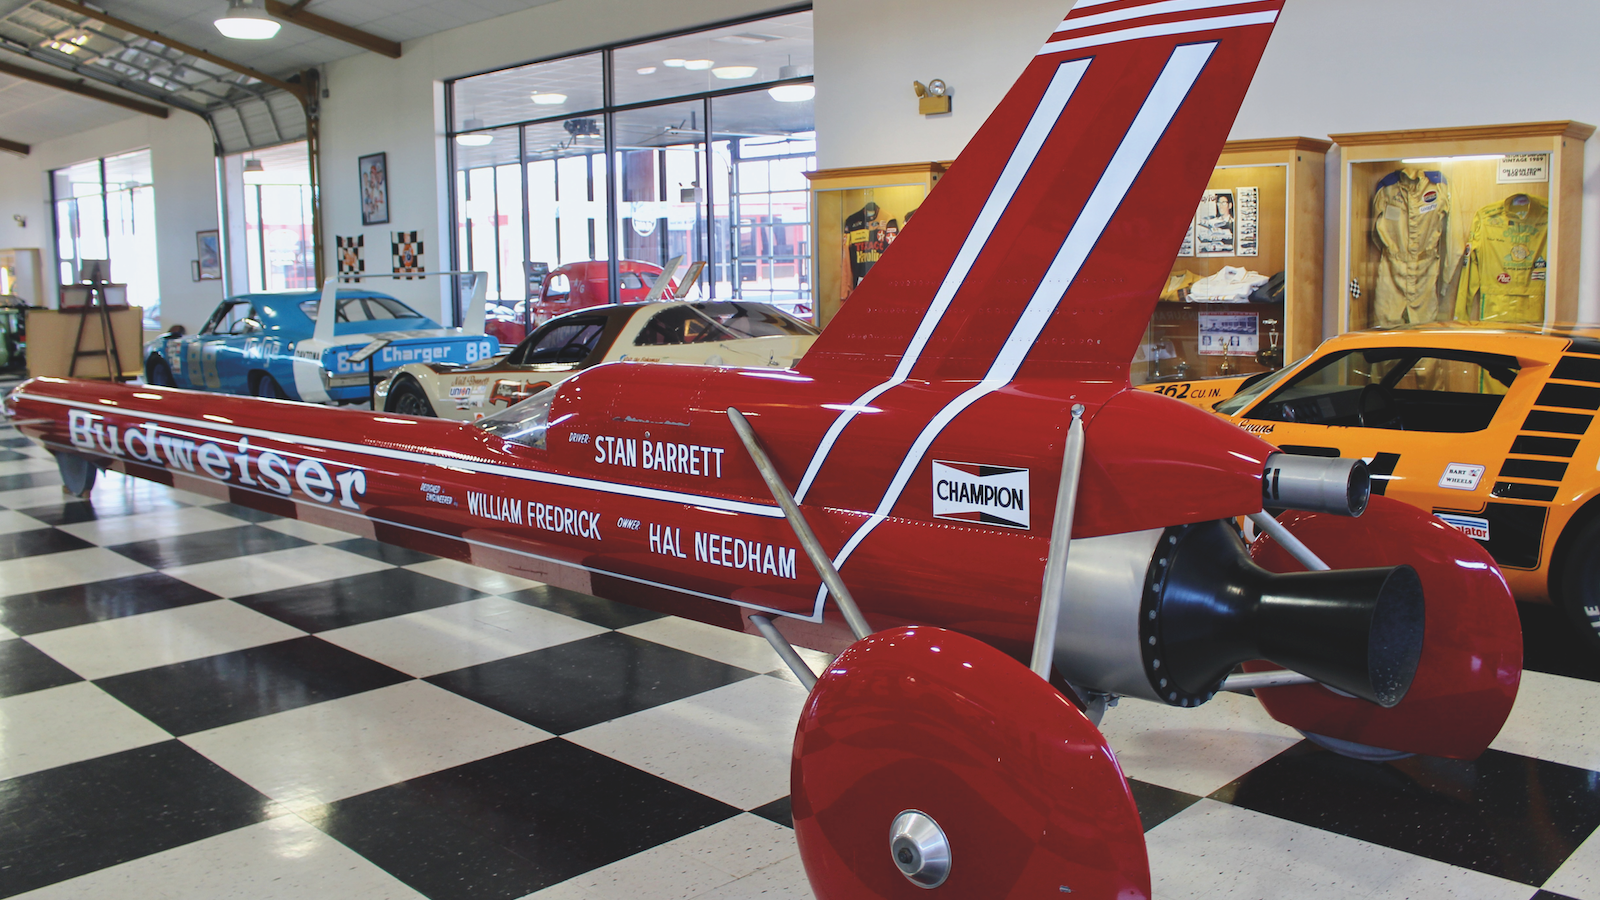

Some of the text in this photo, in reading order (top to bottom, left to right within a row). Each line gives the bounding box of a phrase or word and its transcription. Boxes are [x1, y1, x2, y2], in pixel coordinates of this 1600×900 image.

[1503, 223, 1539, 237] COUNTRY
[1511, 234, 1531, 243] TIME
[856, 249, 883, 263] Havolin
[1498, 273, 1511, 283] Post
[244, 336, 281, 368] Dodge
[296, 350, 320, 361] DAYTONA
[382, 346, 451, 363] Charger
[466, 341, 491, 362] 88
[187, 342, 221, 388] 88
[1190, 389, 1207, 398] CU.
[1208, 388, 1222, 397] IN.
[1238, 419, 1276, 435] Evans
[68, 408, 367, 511] Budweiser
[568, 432, 725, 478] DRIVER: STAN BARRETT
[936, 479, 1024, 511] CHAMPION
[466, 490, 602, 541] WILLIAM FREDRICK
[649, 522, 687, 559] HAL
[694, 531, 797, 580] NEEDHAM
